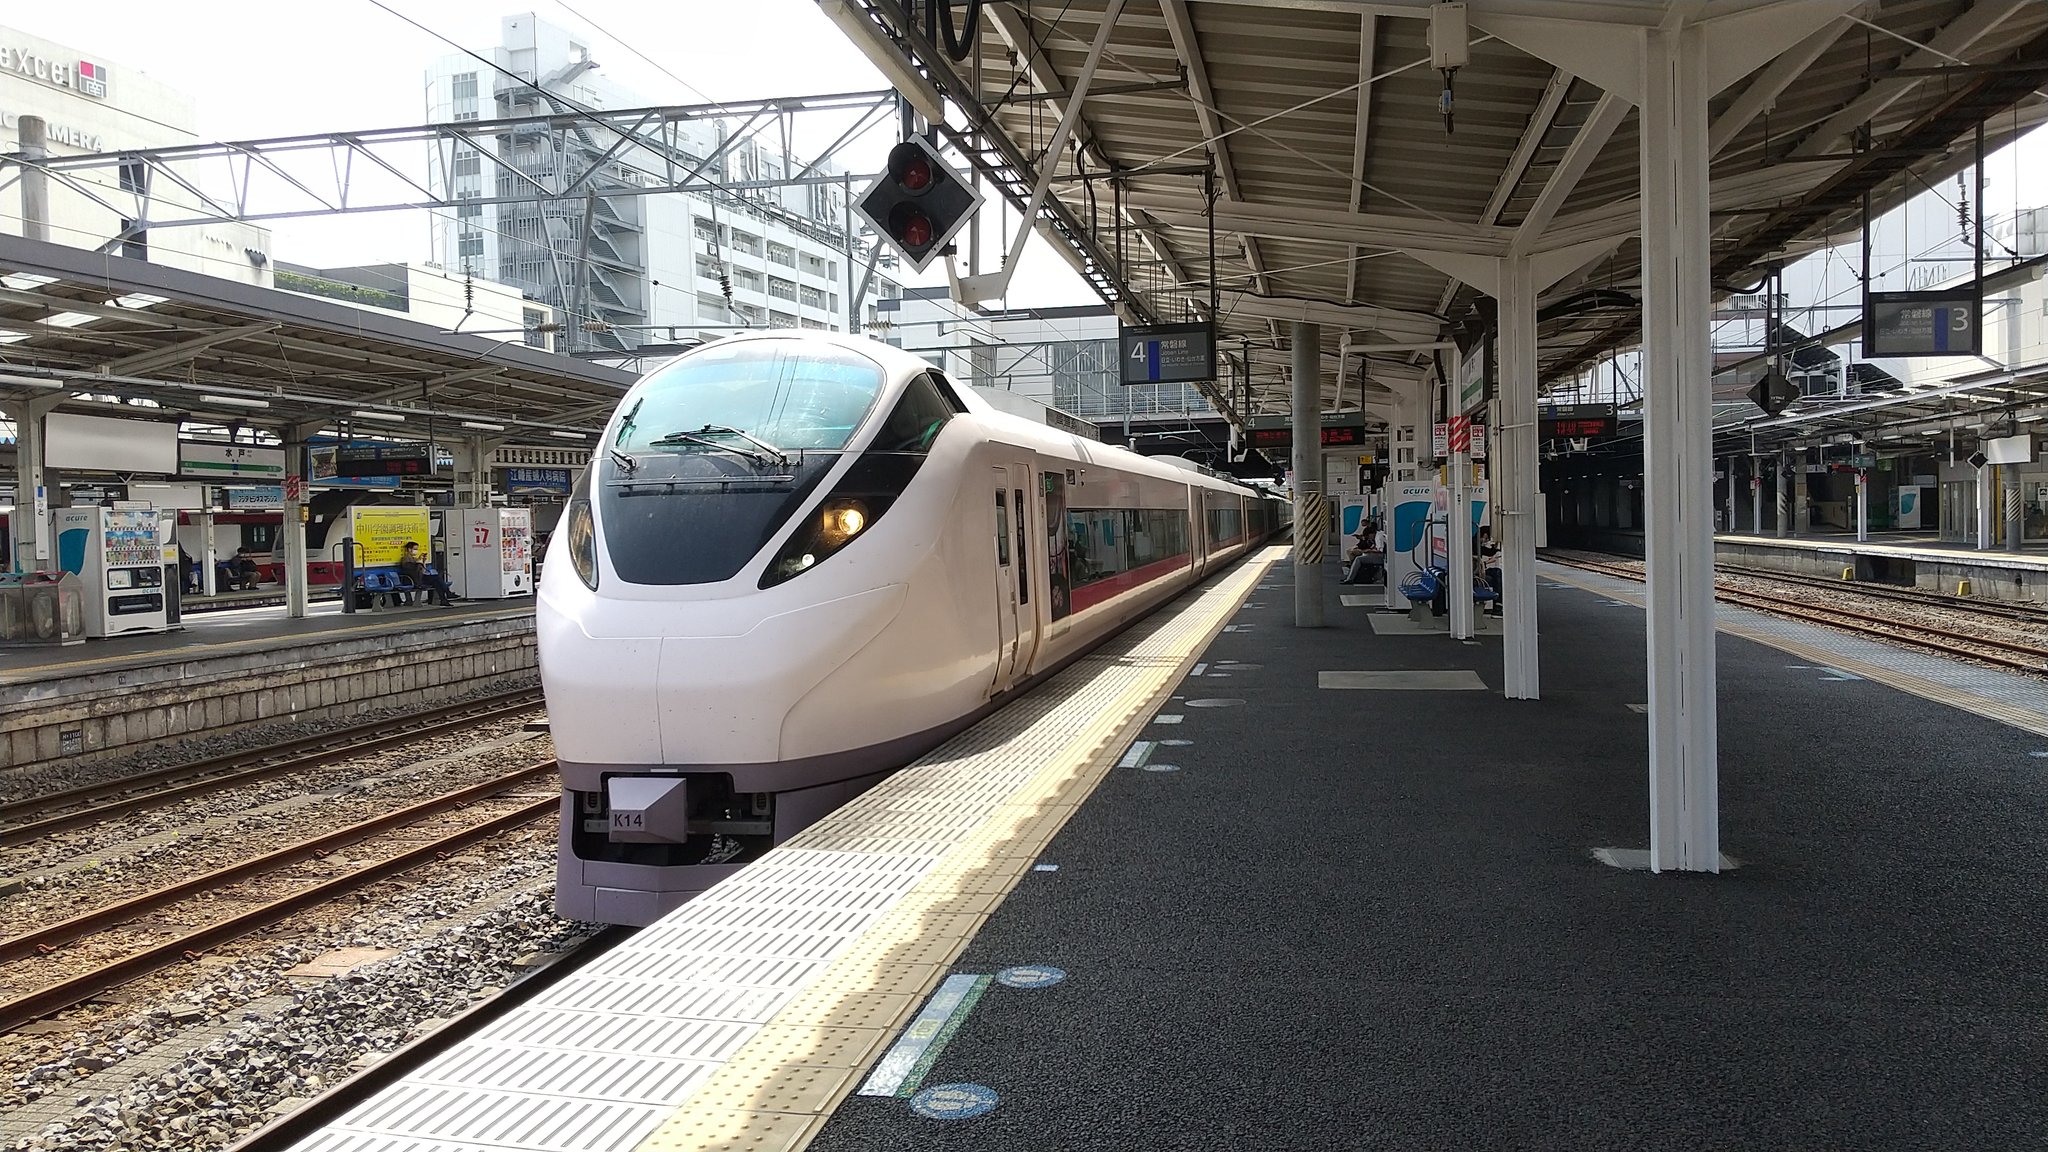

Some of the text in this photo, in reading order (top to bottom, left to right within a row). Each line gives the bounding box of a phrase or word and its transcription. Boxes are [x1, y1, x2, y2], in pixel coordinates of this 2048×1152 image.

[1952, 307, 1969, 331] 3
[1130, 342, 1146, 363] 4
[1606, 404, 1614, 416] 3
[1248, 417, 1256, 428] 4
[420, 446, 427, 457] 5
[1403, 487, 1430, 495] acure
[614, 813, 643, 827] K14
